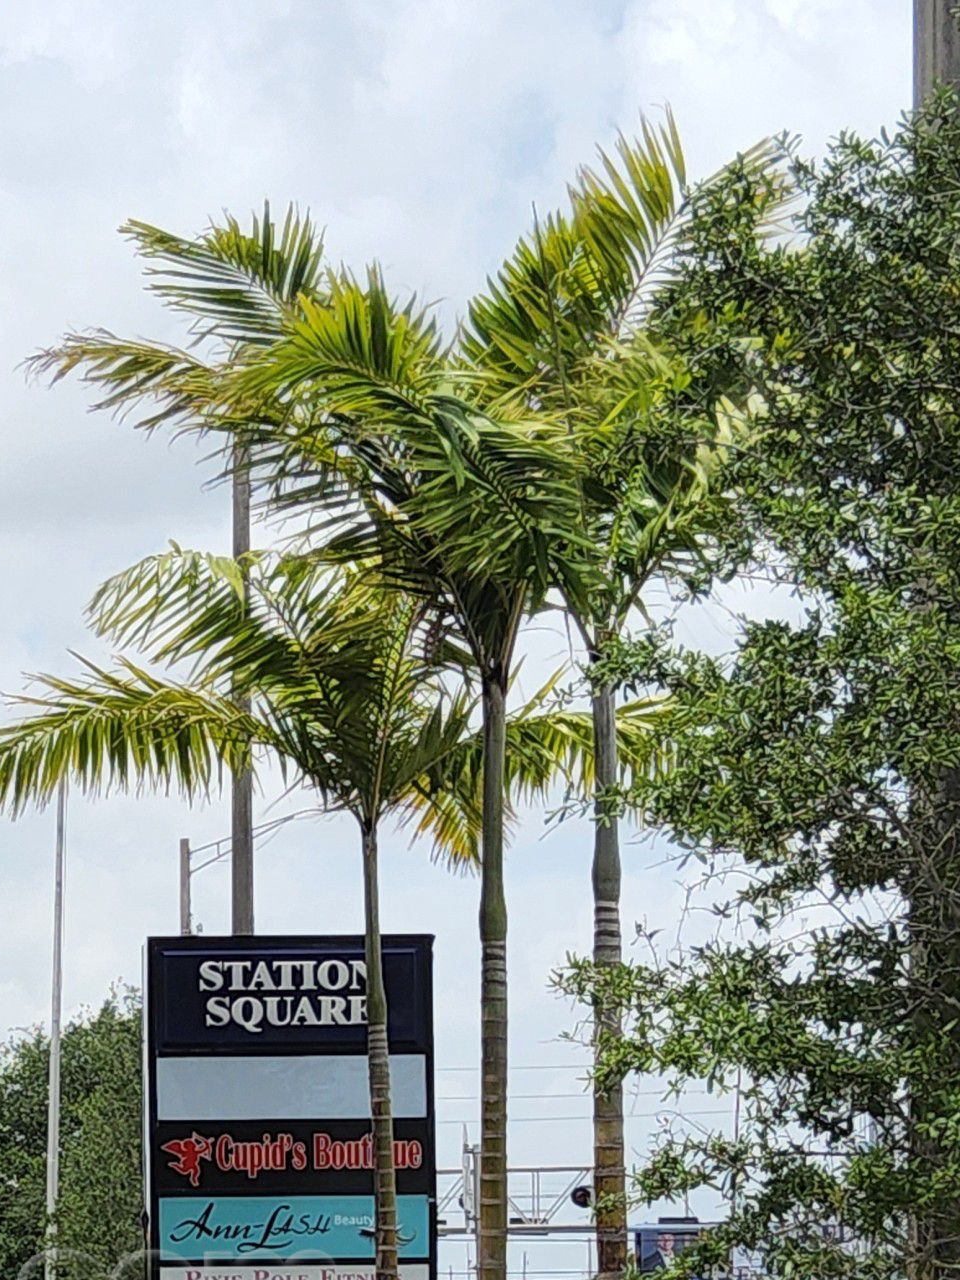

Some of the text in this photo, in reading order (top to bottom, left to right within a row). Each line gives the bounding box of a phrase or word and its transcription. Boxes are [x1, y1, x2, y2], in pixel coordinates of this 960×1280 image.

[198, 959, 371, 992] STATION
[205, 995, 373, 1033] SQUARE
[215, 1132, 423, 1178] Cupid's Boutiue
[333, 1214, 375, 1228] Beauty
